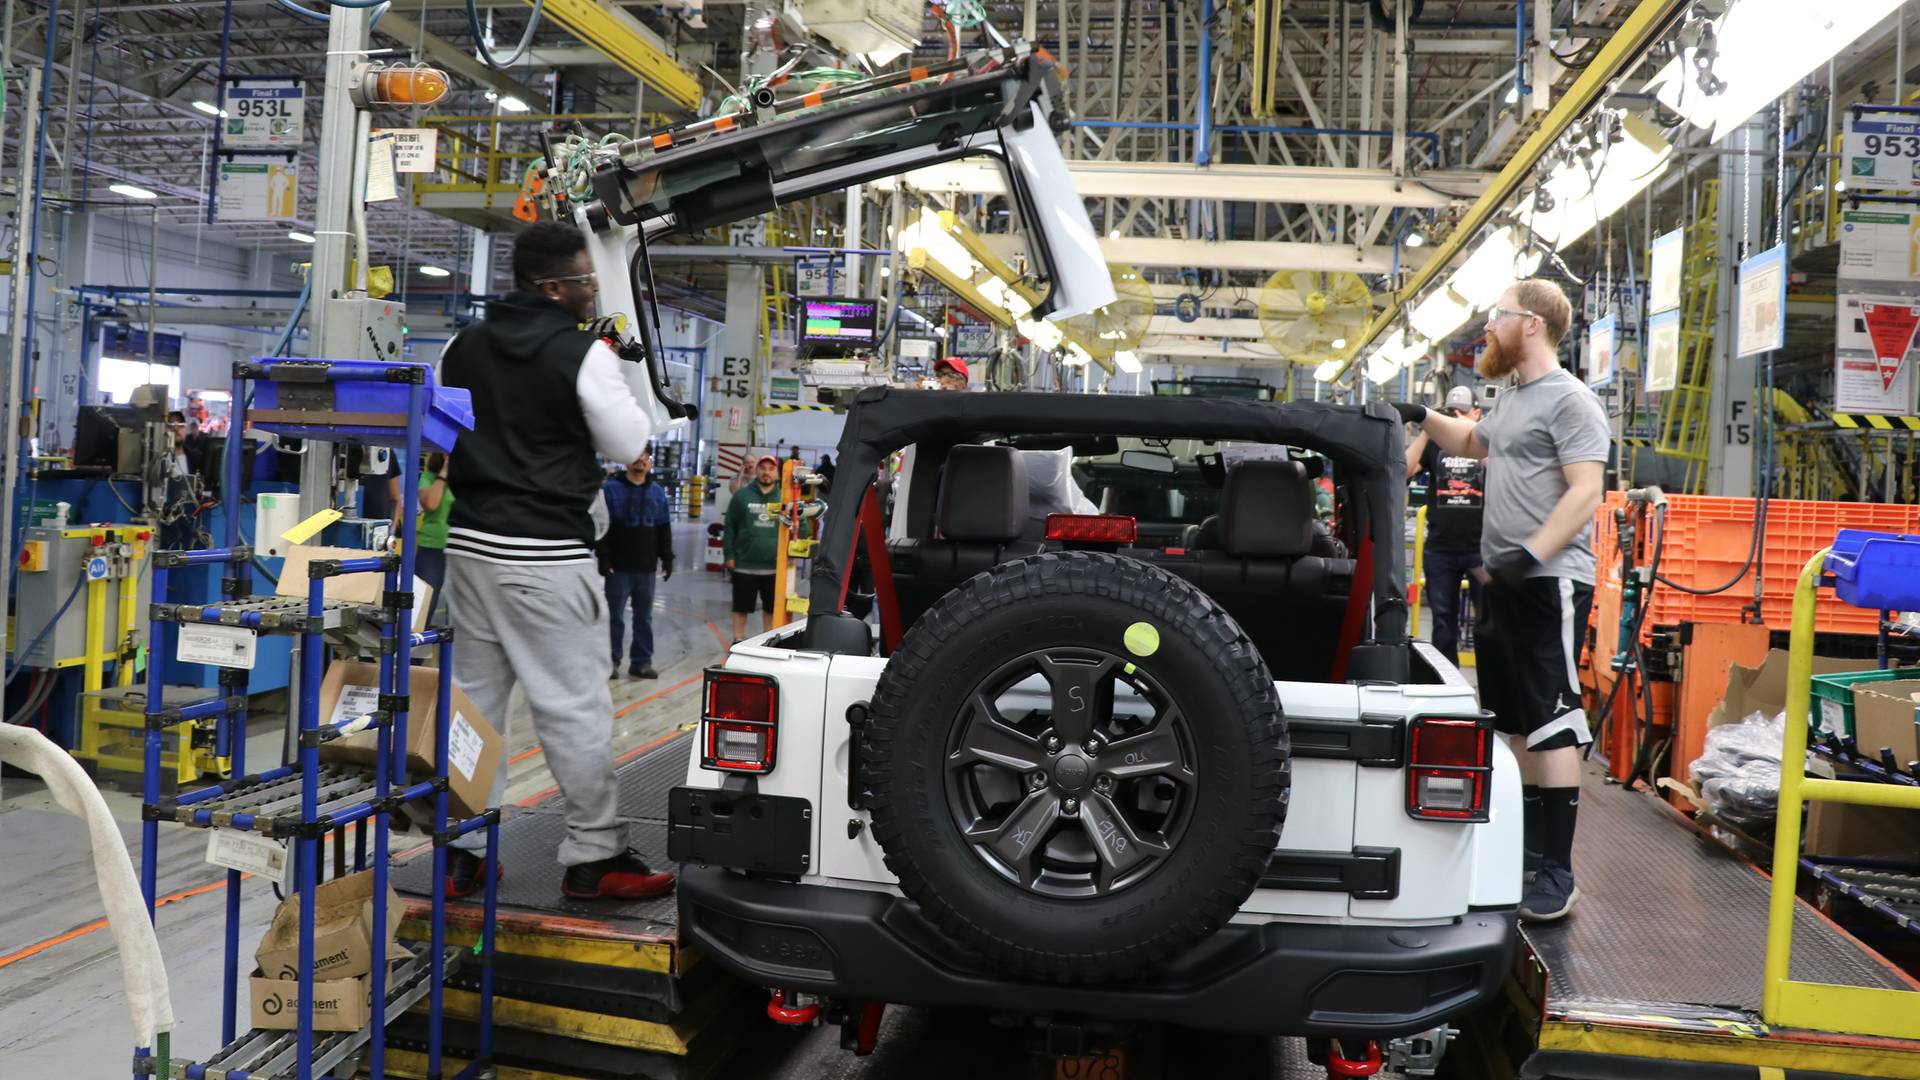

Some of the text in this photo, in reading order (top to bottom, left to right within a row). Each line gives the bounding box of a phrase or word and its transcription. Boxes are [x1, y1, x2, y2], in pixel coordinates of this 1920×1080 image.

[252, 89, 273, 97] Final
[238, 99, 292, 117] 953L
[1886, 123, 1914, 133] Final
[1864, 134, 1920, 158] 953
[805, 269, 838, 280] 954
[723, 356, 751, 376] E3
[726, 379, 749, 398] 15
[1732, 401, 1747, 421] F
[1726, 424, 1750, 445] 15
[313, 950, 349, 969] ument
